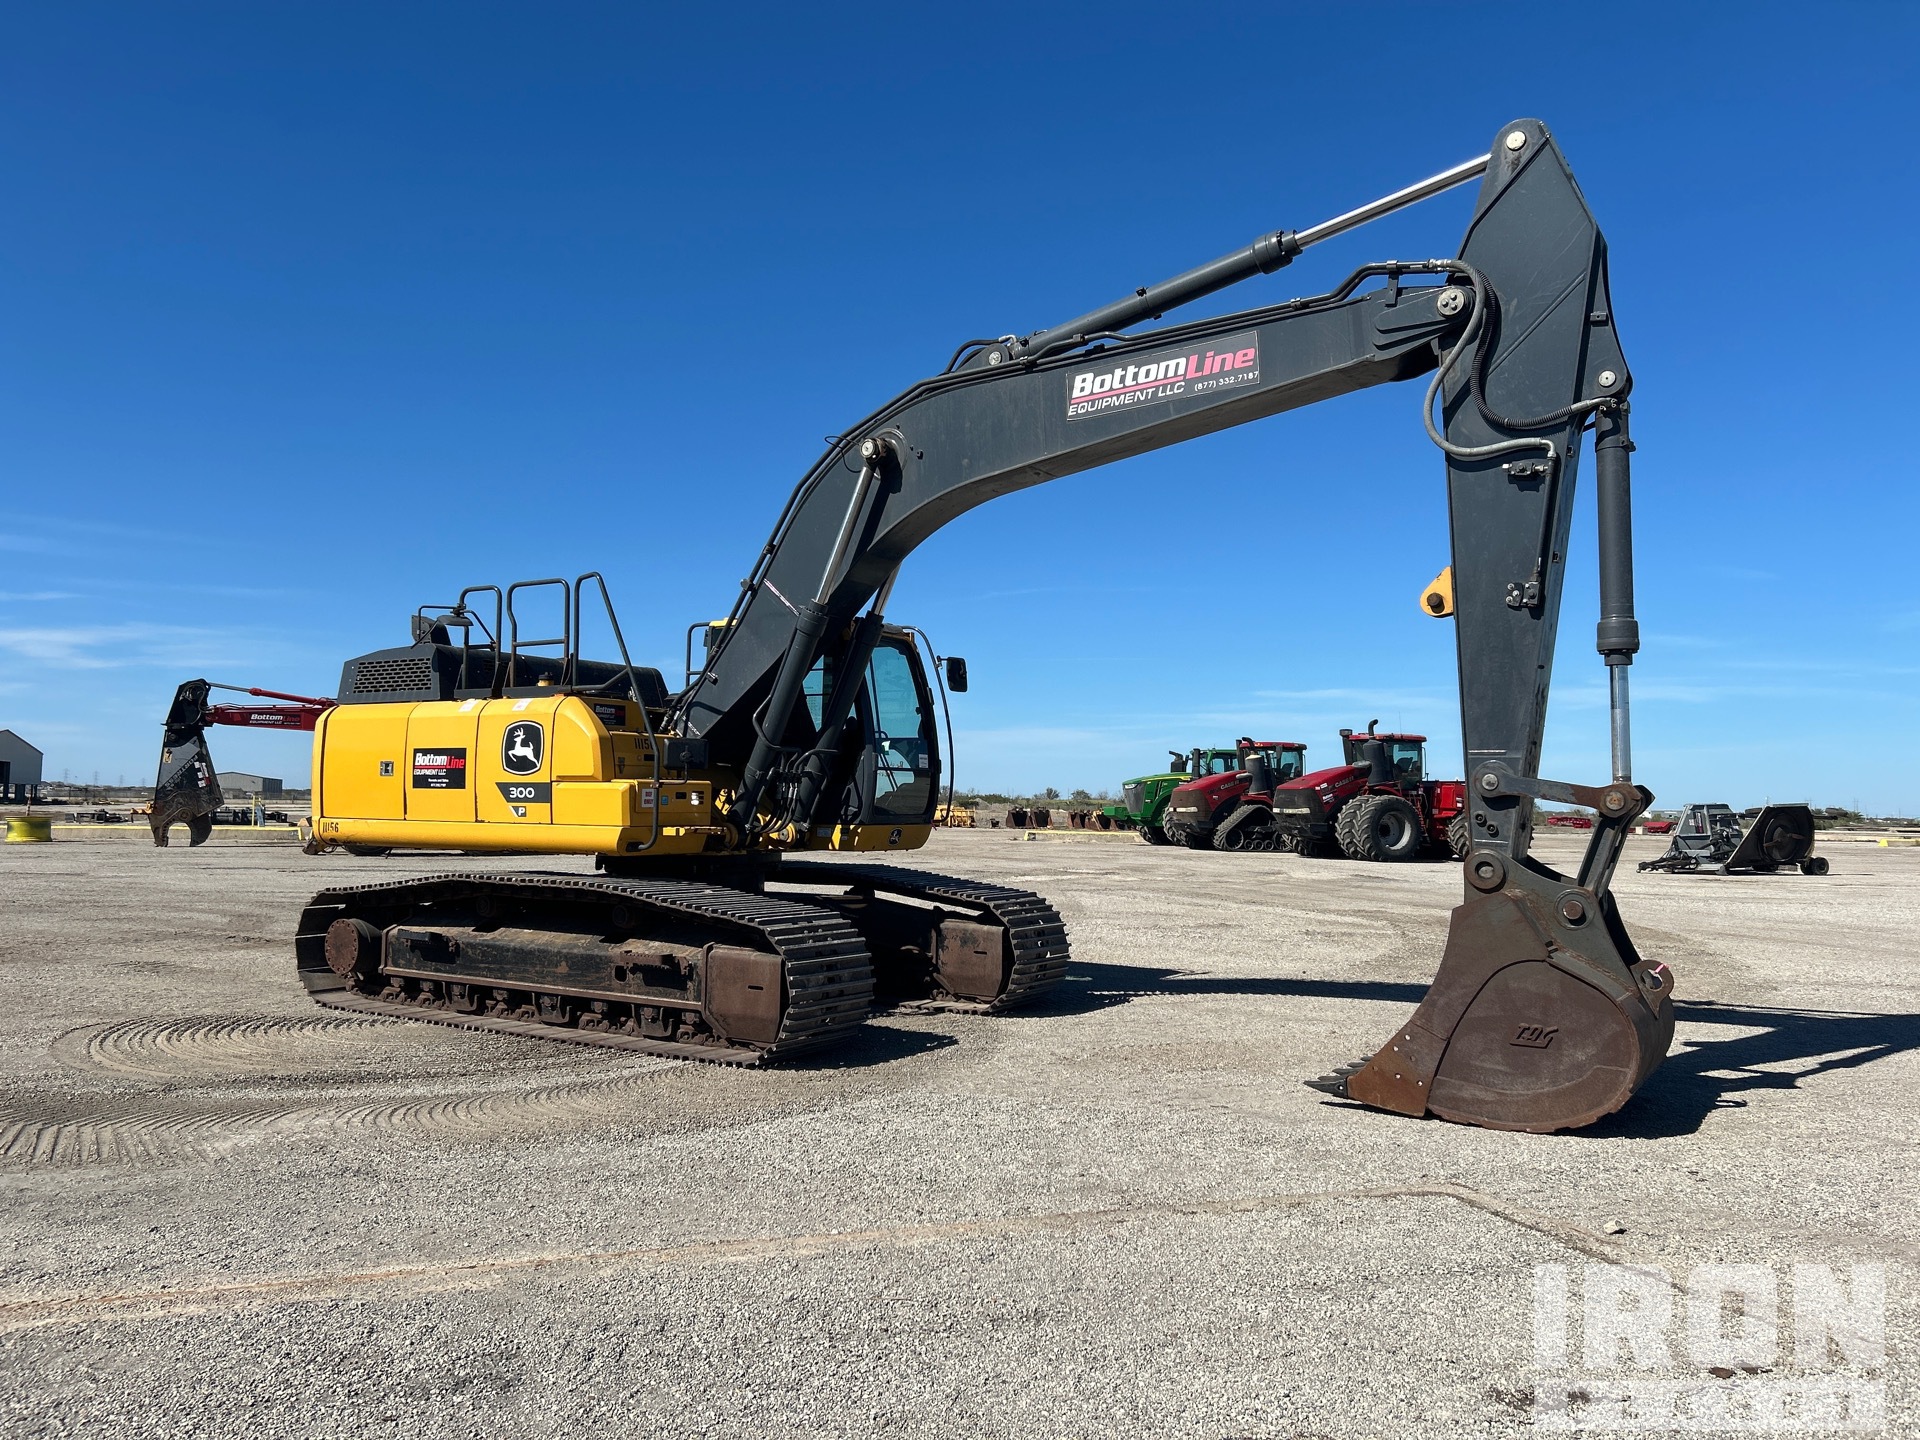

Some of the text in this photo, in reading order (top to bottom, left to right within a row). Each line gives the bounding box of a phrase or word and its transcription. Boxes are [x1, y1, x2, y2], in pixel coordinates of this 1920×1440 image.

[1071, 347, 1256, 399] BottomLine
[1194, 371, 1259, 393] (877) 332.7187
[1068, 381, 1185, 416] EQUIPMENT LLC
[415, 753, 465, 768] BottomLine
[509, 787, 535, 798] 300
[1220, 781, 1234, 790] CASE
[518, 807, 526, 816] P
